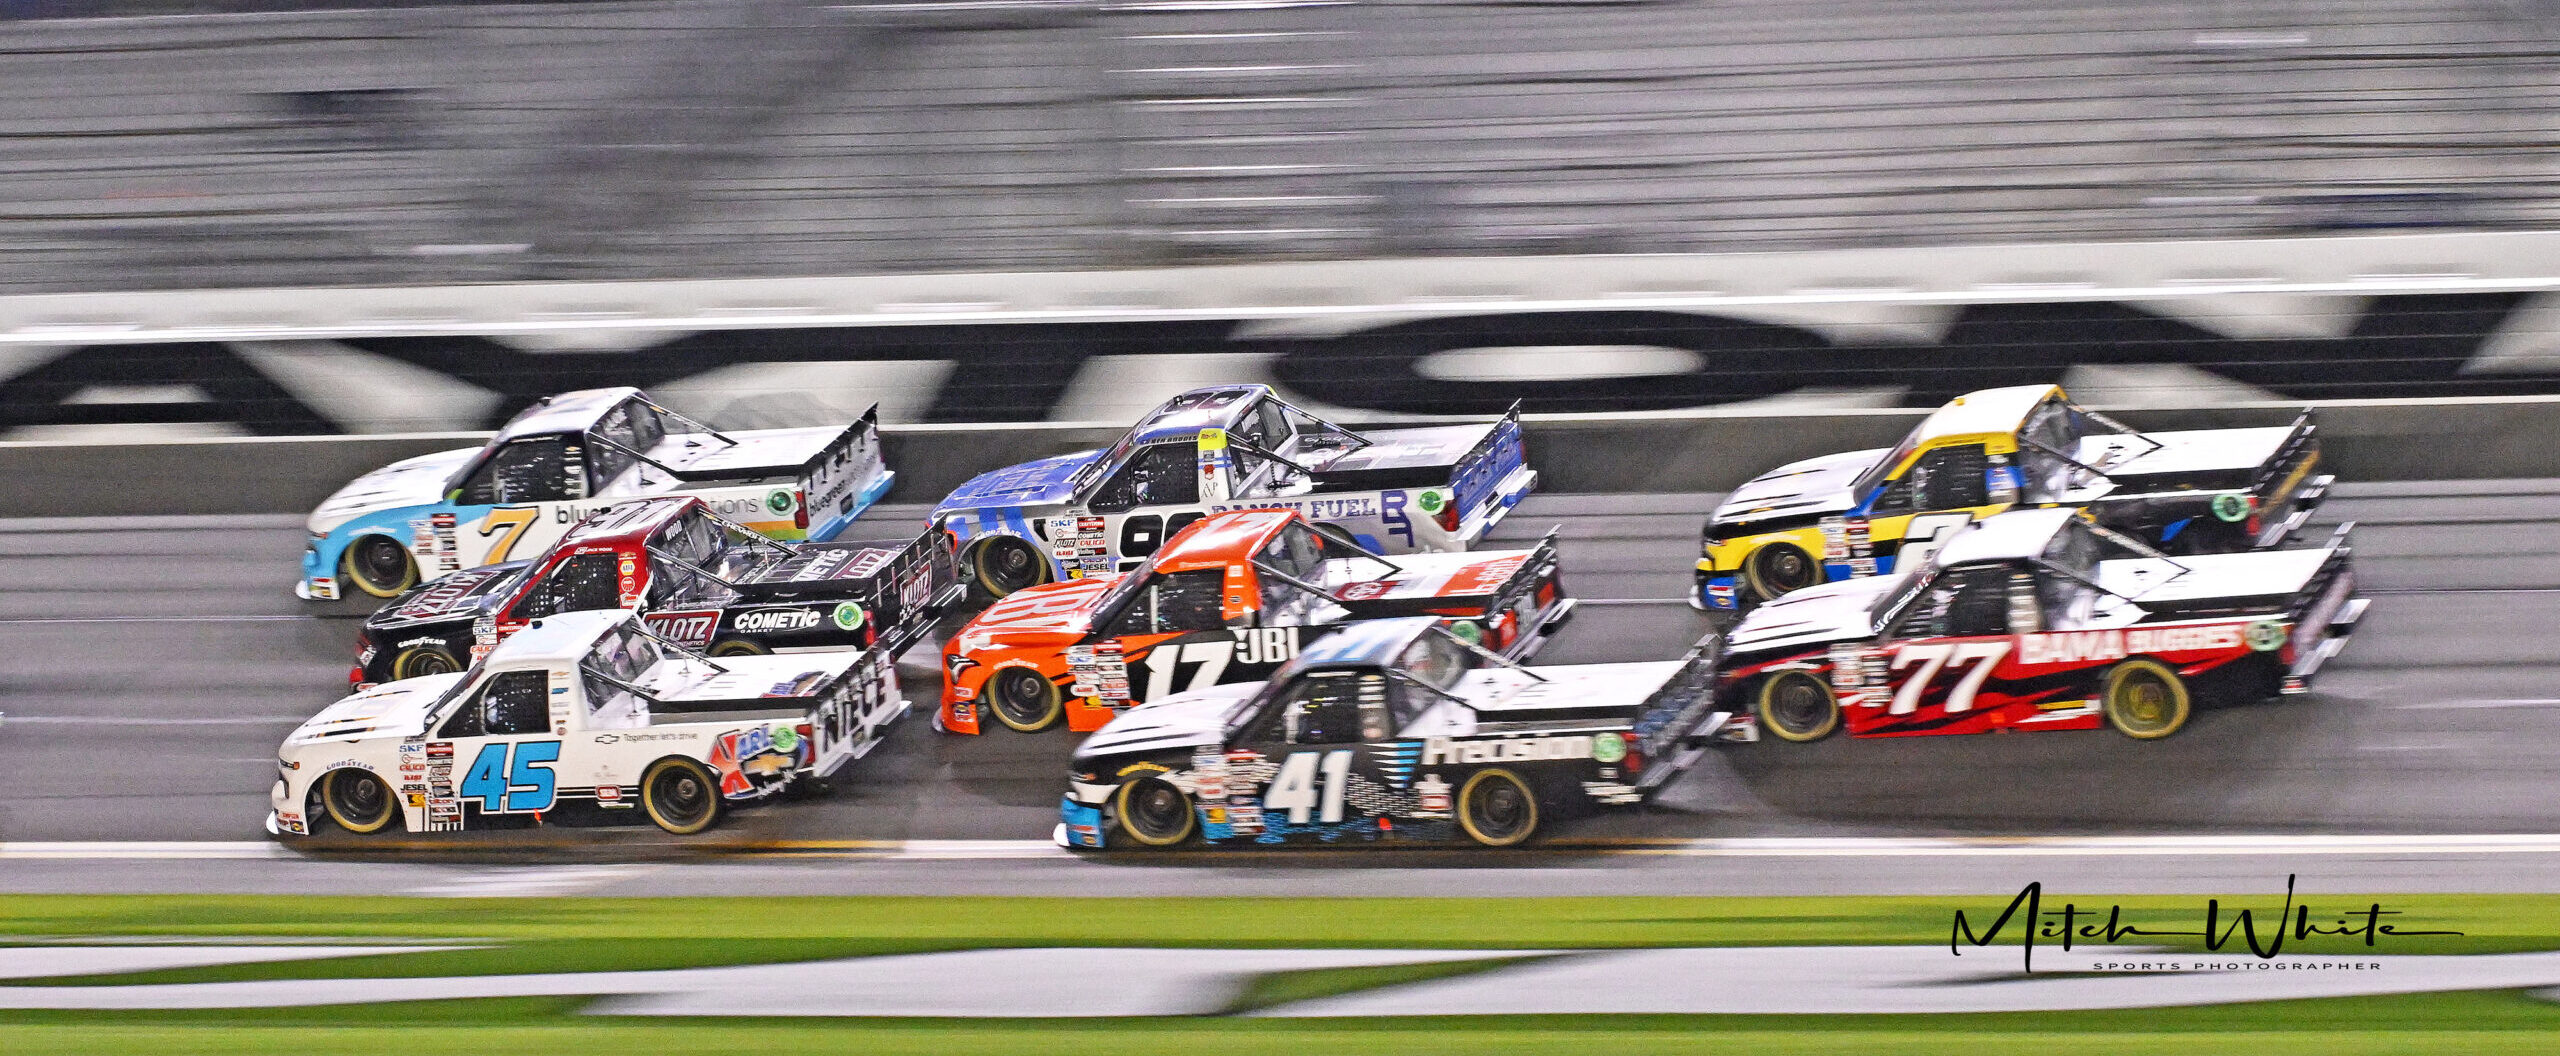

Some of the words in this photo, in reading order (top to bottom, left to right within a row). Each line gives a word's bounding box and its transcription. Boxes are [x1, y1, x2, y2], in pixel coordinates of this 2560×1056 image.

[1311, 499, 1376, 518] FUEL
[664, 519, 683, 541] WOOD
[1051, 519, 1075, 527] SKF
[478, 506, 539, 566] 7
[1080, 539, 1105, 547] CALICO
[1084, 563, 1109, 571] JESEL
[648, 616, 712, 641] KLOTZ
[734, 610, 821, 629] COMETIC
[398, 636, 447, 648] GOODYEAR
[1144, 641, 1235, 703] 17
[1888, 641, 2012, 715] 77
[624, 733, 657, 742] Together
[678, 732, 698, 740] drive
[399, 744, 425, 753] SKF
[1421, 734, 1594, 765] Precision
[326, 758, 375, 771] GOODYEAR
[399, 763, 425, 771] CALICO
[461, 740, 562, 811] 45
[1263, 750, 1354, 824] 41
